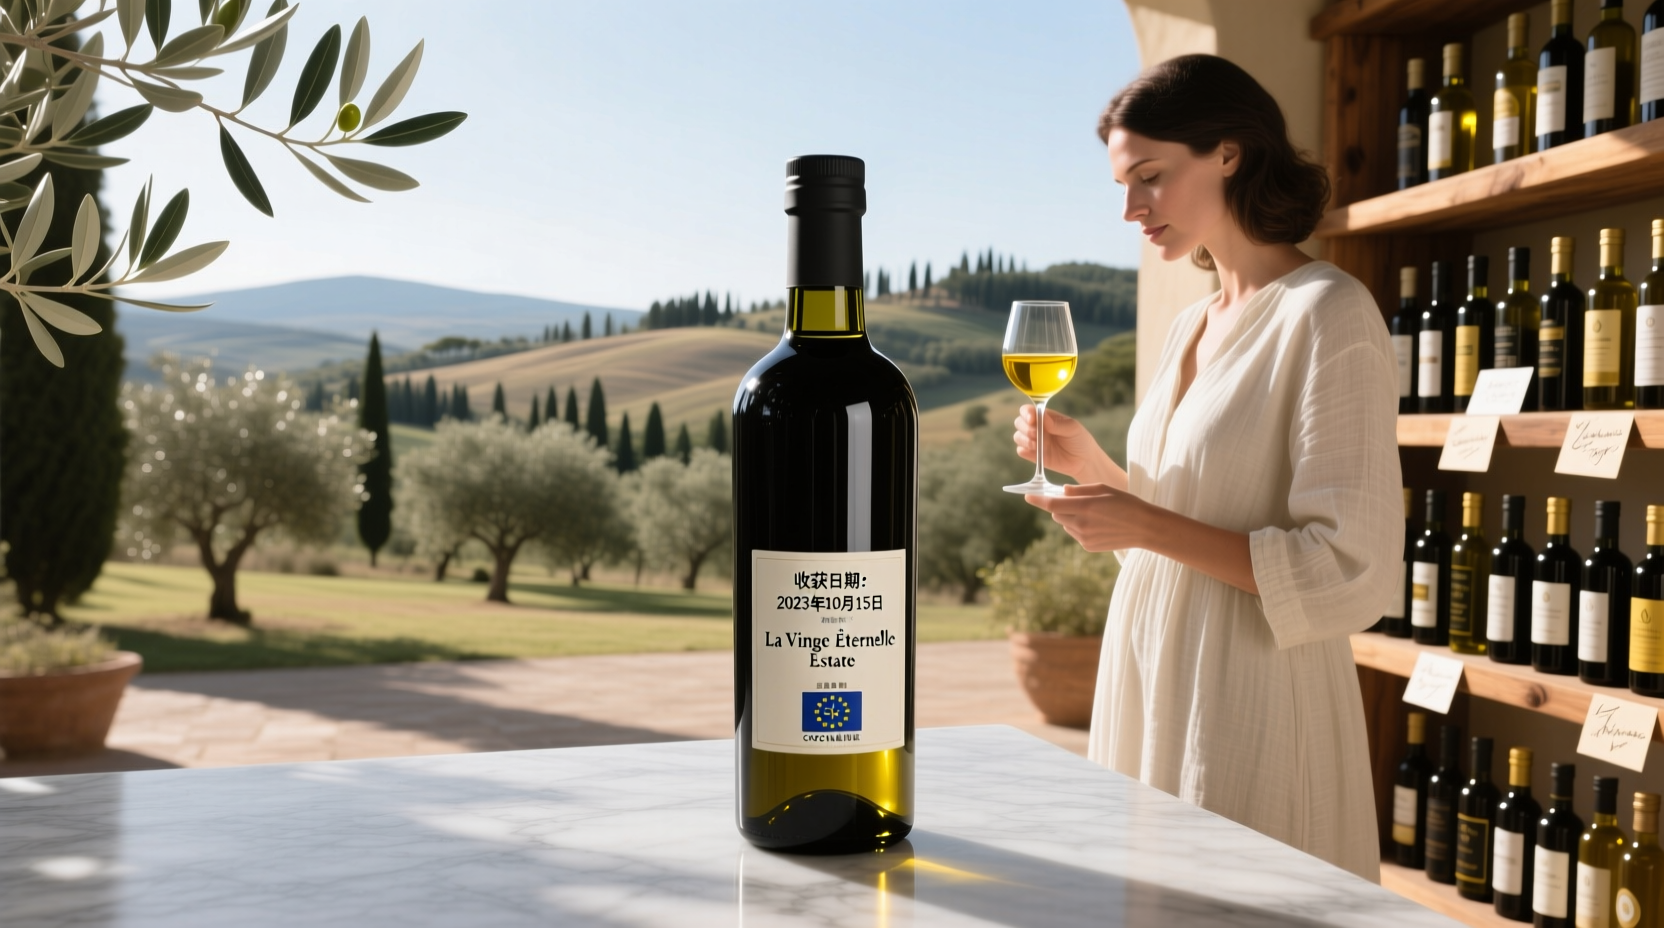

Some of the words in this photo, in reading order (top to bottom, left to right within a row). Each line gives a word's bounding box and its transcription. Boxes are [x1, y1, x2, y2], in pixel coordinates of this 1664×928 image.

[777, 595, 883, 611] 2023年10月15日
[765, 631, 782, 647] La
[809, 653, 856, 668] Estate
